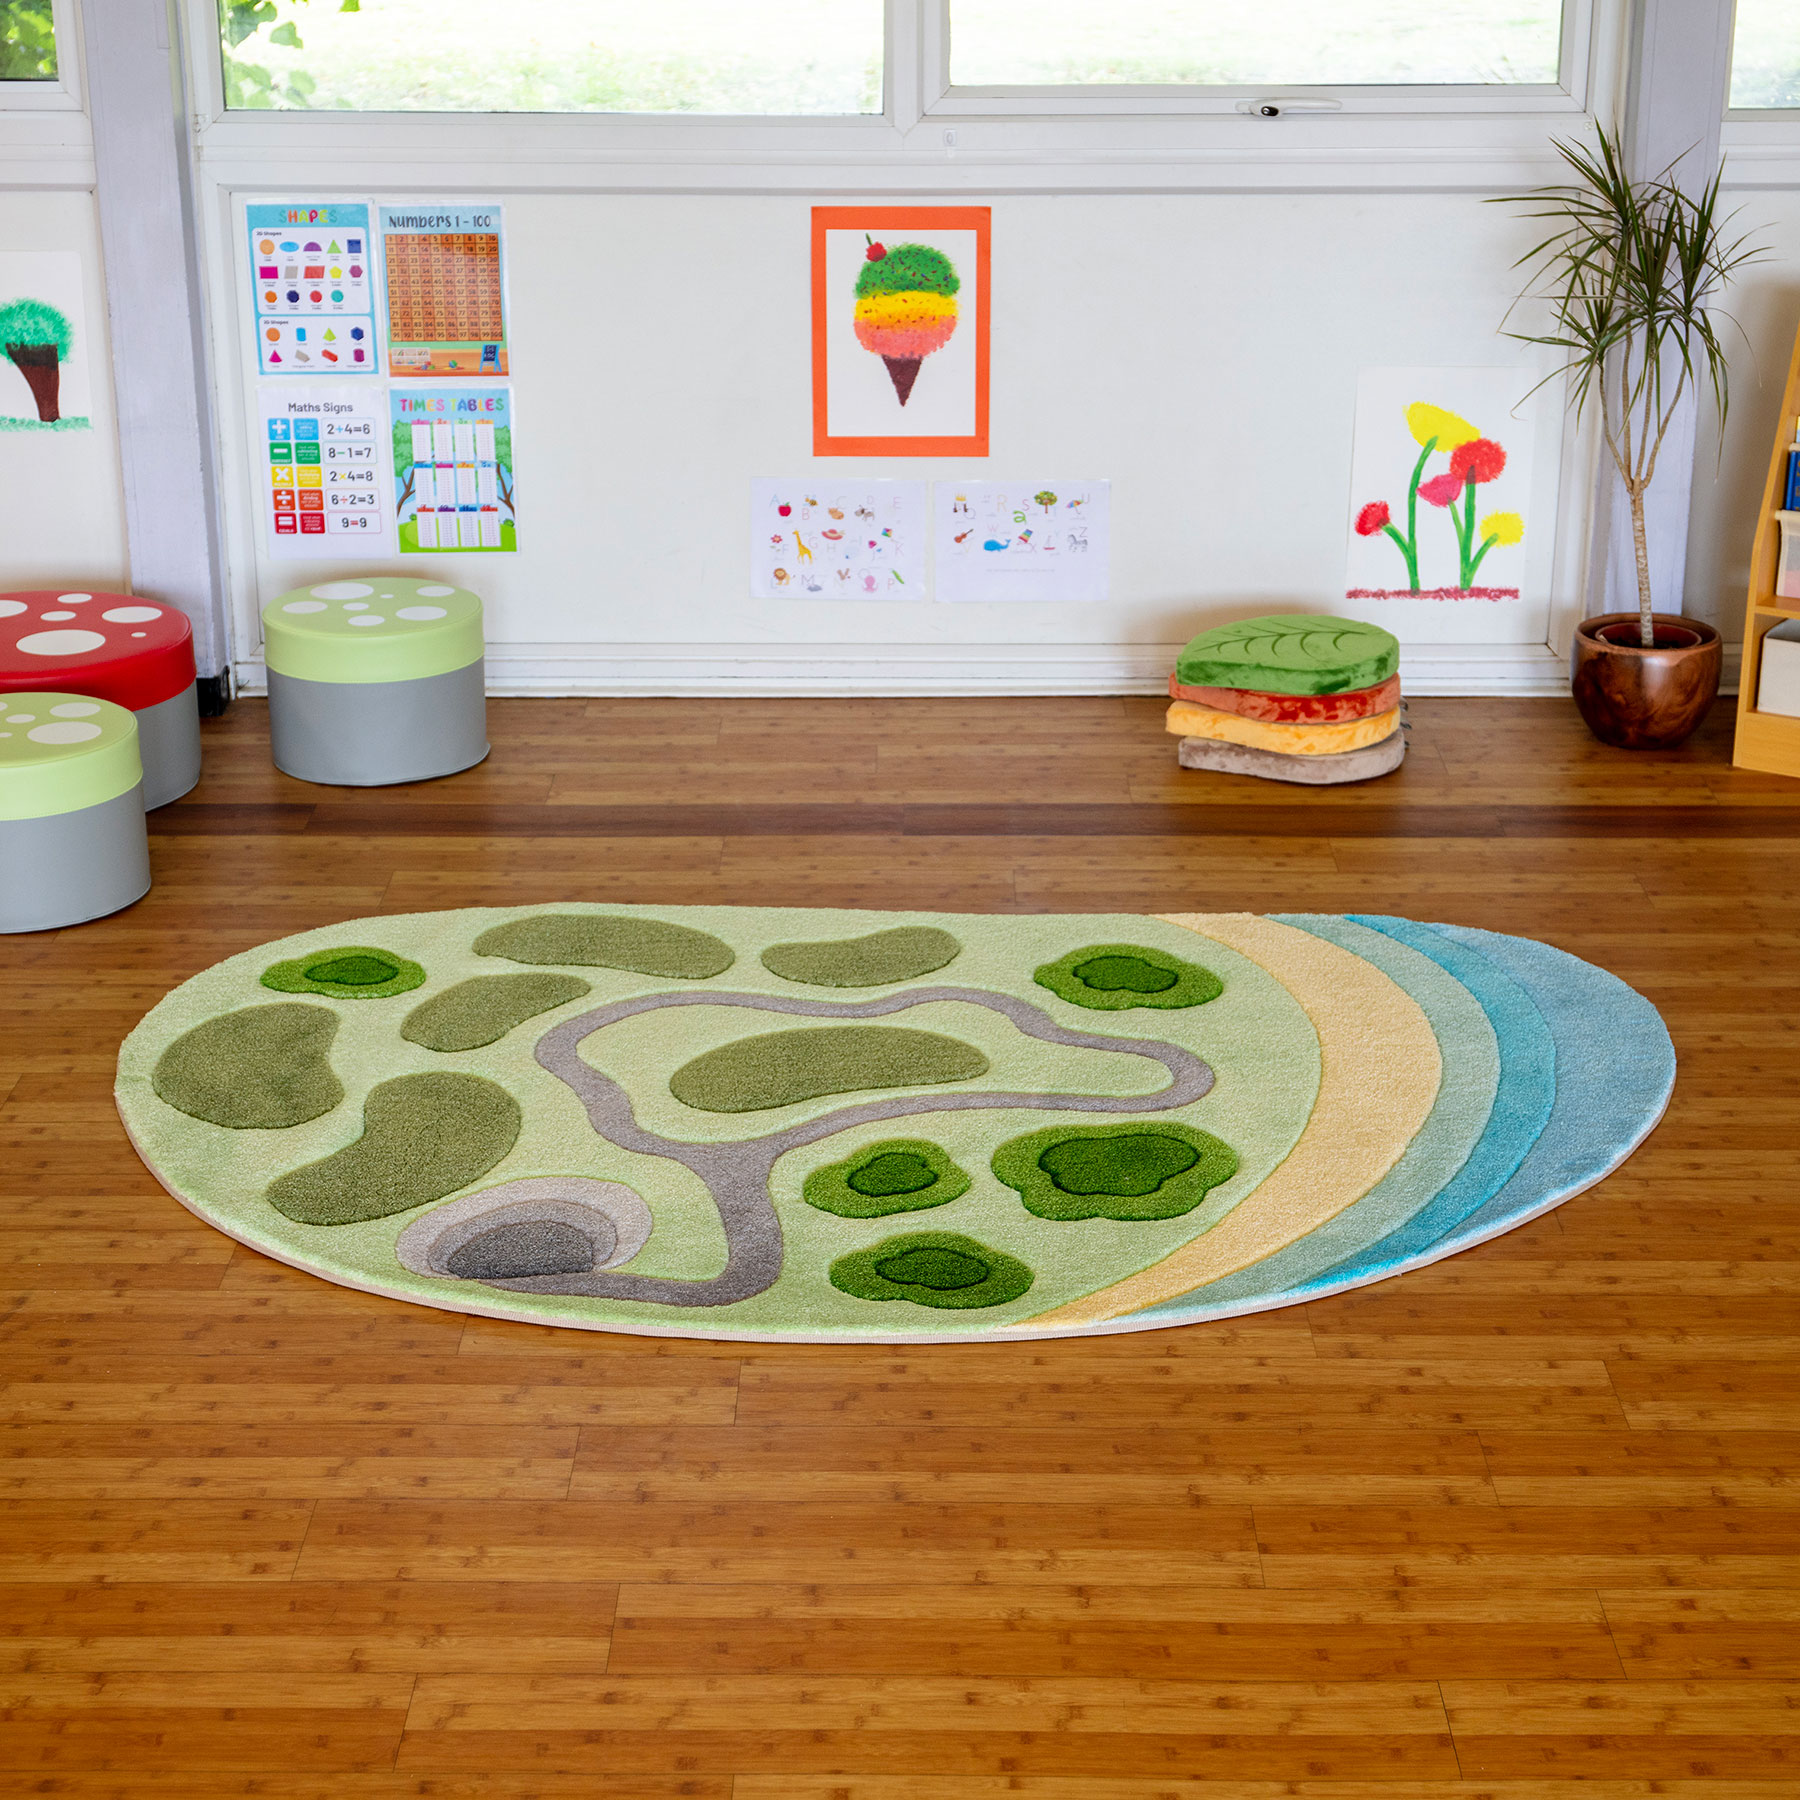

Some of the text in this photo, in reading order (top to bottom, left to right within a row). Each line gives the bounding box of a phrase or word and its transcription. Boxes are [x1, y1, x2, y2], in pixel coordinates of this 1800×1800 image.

[278, 209, 338, 223] SHAPES
[388, 215, 452, 228] Numbers
[455, 215, 460, 227] 1
[473, 214, 491, 227] 100
[288, 403, 354, 414] Maths Signs
[399, 398, 505, 412] TIMES TABLES
[769, 494, 780, 507] A
[867, 496, 874, 504] D
[893, 496, 902, 509] E
[997, 495, 1008, 512] R
[1022, 499, 1031, 511] S
[1082, 494, 1090, 504] U
[801, 508, 810, 520] B
[987, 524, 999, 532] W
[1079, 527, 1088, 537] Z
[808, 536, 818, 549] G
[826, 543, 836, 552] H
[894, 543, 904, 557] K
[801, 574, 815, 585] M
[887, 578, 894, 590] P
